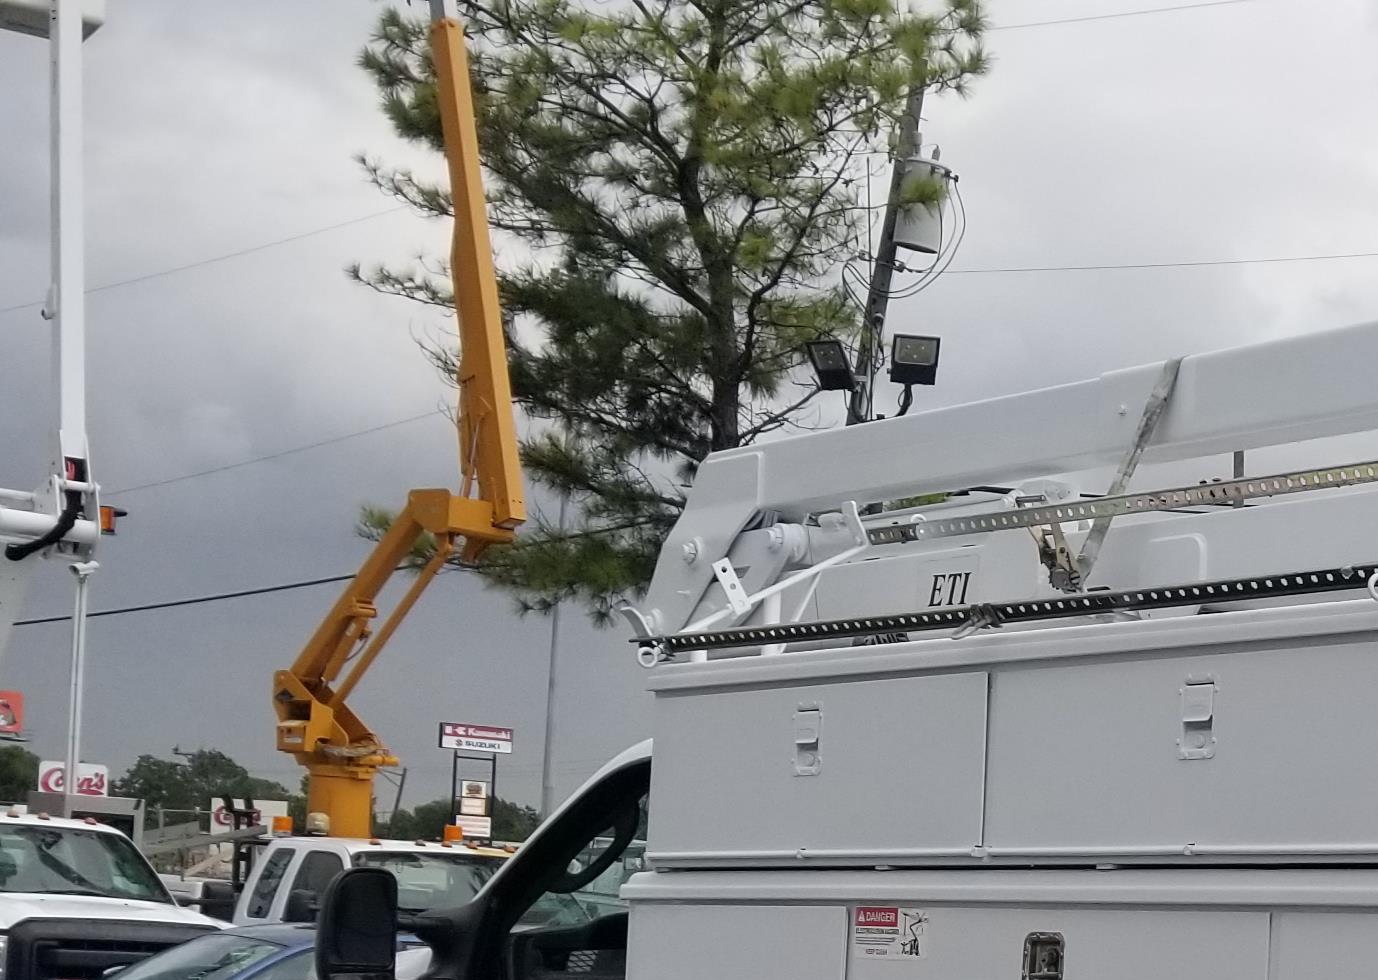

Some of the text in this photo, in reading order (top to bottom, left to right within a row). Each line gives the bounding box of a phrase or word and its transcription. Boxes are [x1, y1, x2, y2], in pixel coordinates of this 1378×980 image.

[928, 572, 972, 607] ETI
[465, 740, 500, 750] SUZUKI
[866, 911, 896, 922] DANGER
